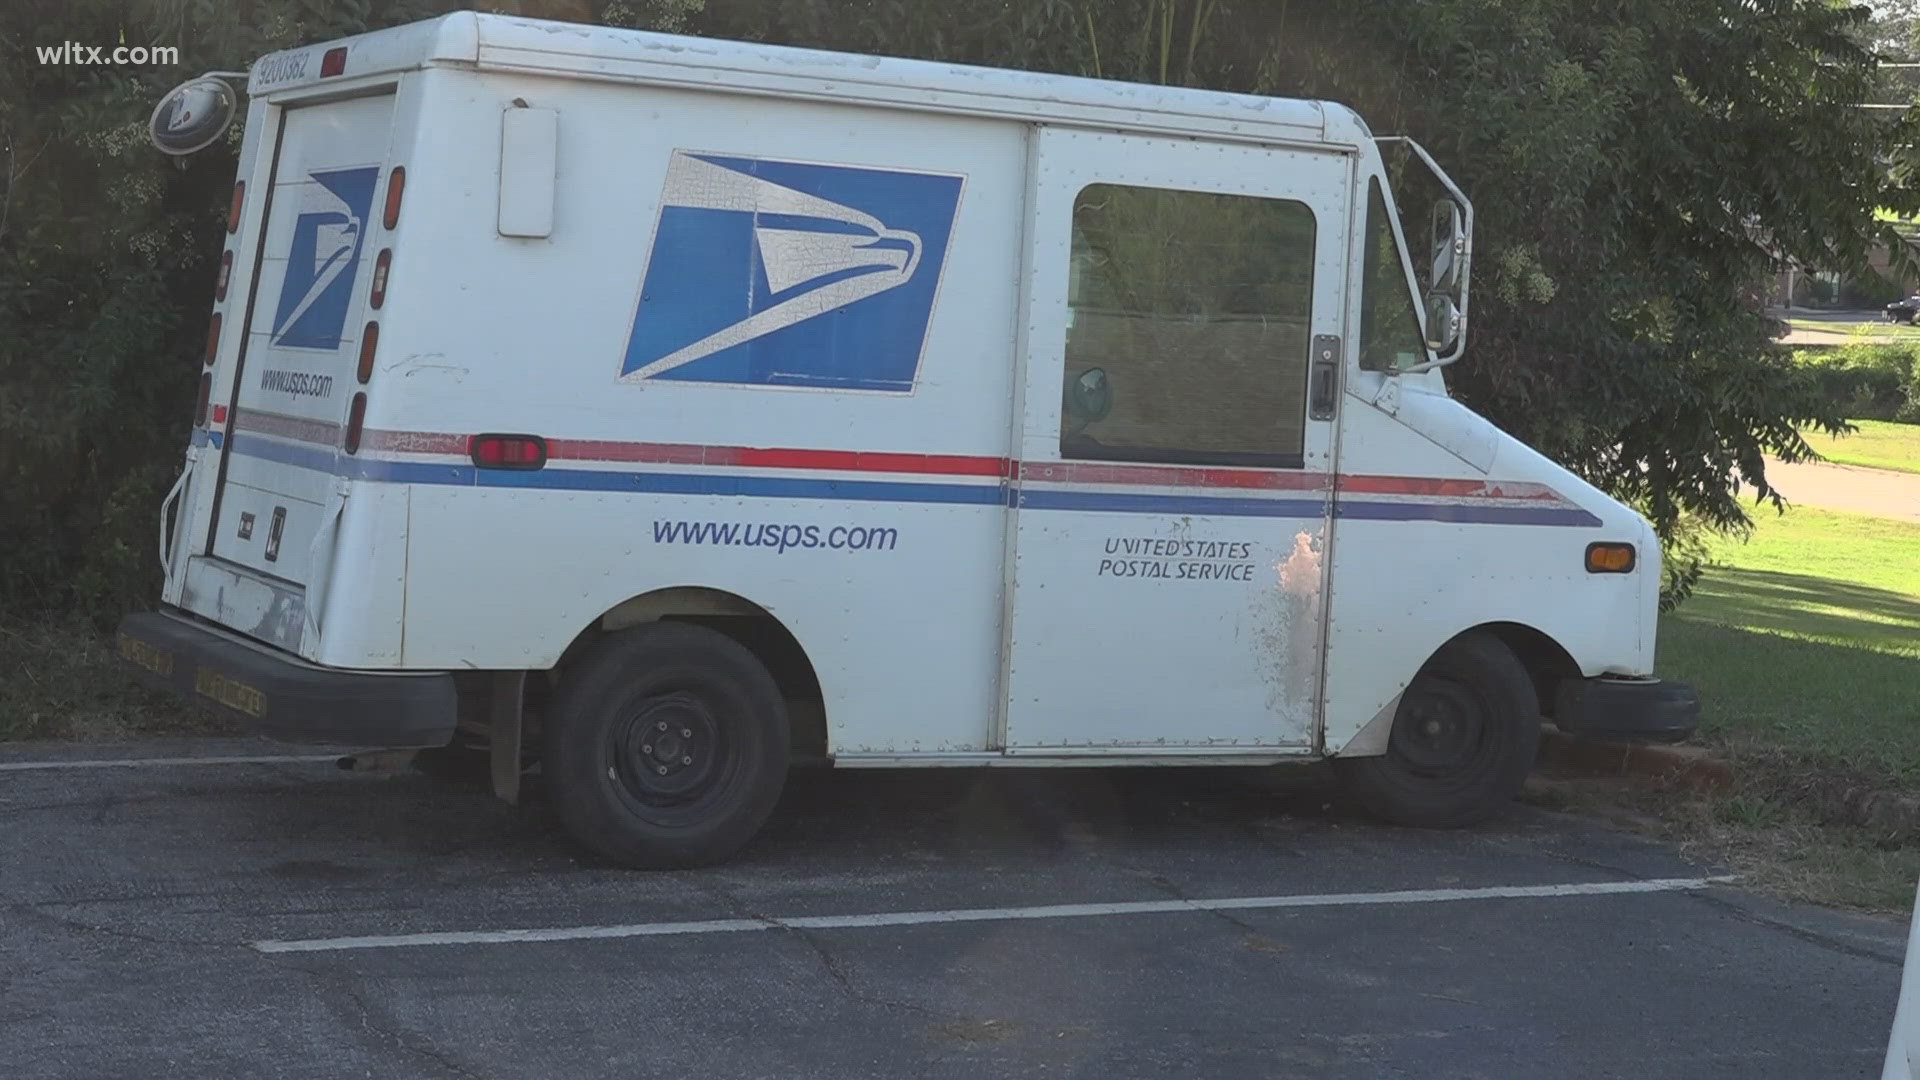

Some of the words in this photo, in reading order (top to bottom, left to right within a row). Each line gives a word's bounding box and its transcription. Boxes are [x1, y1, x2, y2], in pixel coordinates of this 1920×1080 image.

[261, 369, 332, 399] www.usps.com
[653, 521, 898, 554] www.usps.com
[1104, 538, 1180, 556] UNITED
[1184, 541, 1251, 559] STATES
[1098, 559, 1171, 578] POSTAL
[1177, 563, 1255, 581] SERVICE
